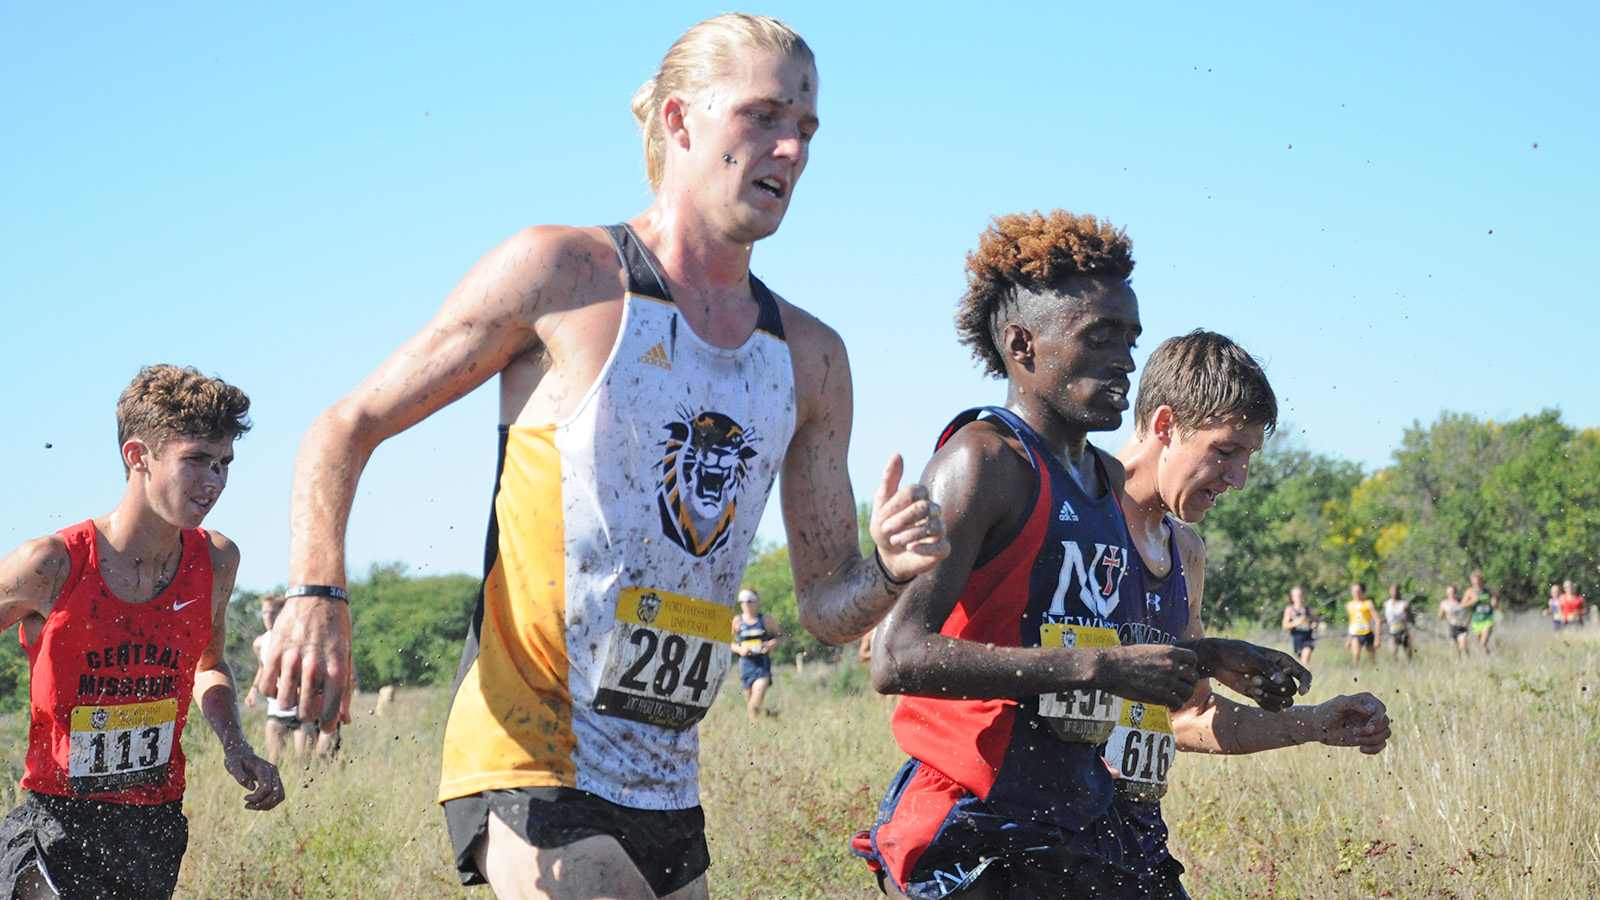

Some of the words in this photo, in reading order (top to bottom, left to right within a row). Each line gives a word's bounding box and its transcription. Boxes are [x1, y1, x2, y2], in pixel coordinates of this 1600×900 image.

[640, 352, 672, 371] adidas
[86, 643, 181, 671] CENTRAL
[618, 628, 713, 702] 284
[89, 727, 160, 774] 113
[1121, 730, 1171, 782] 616
